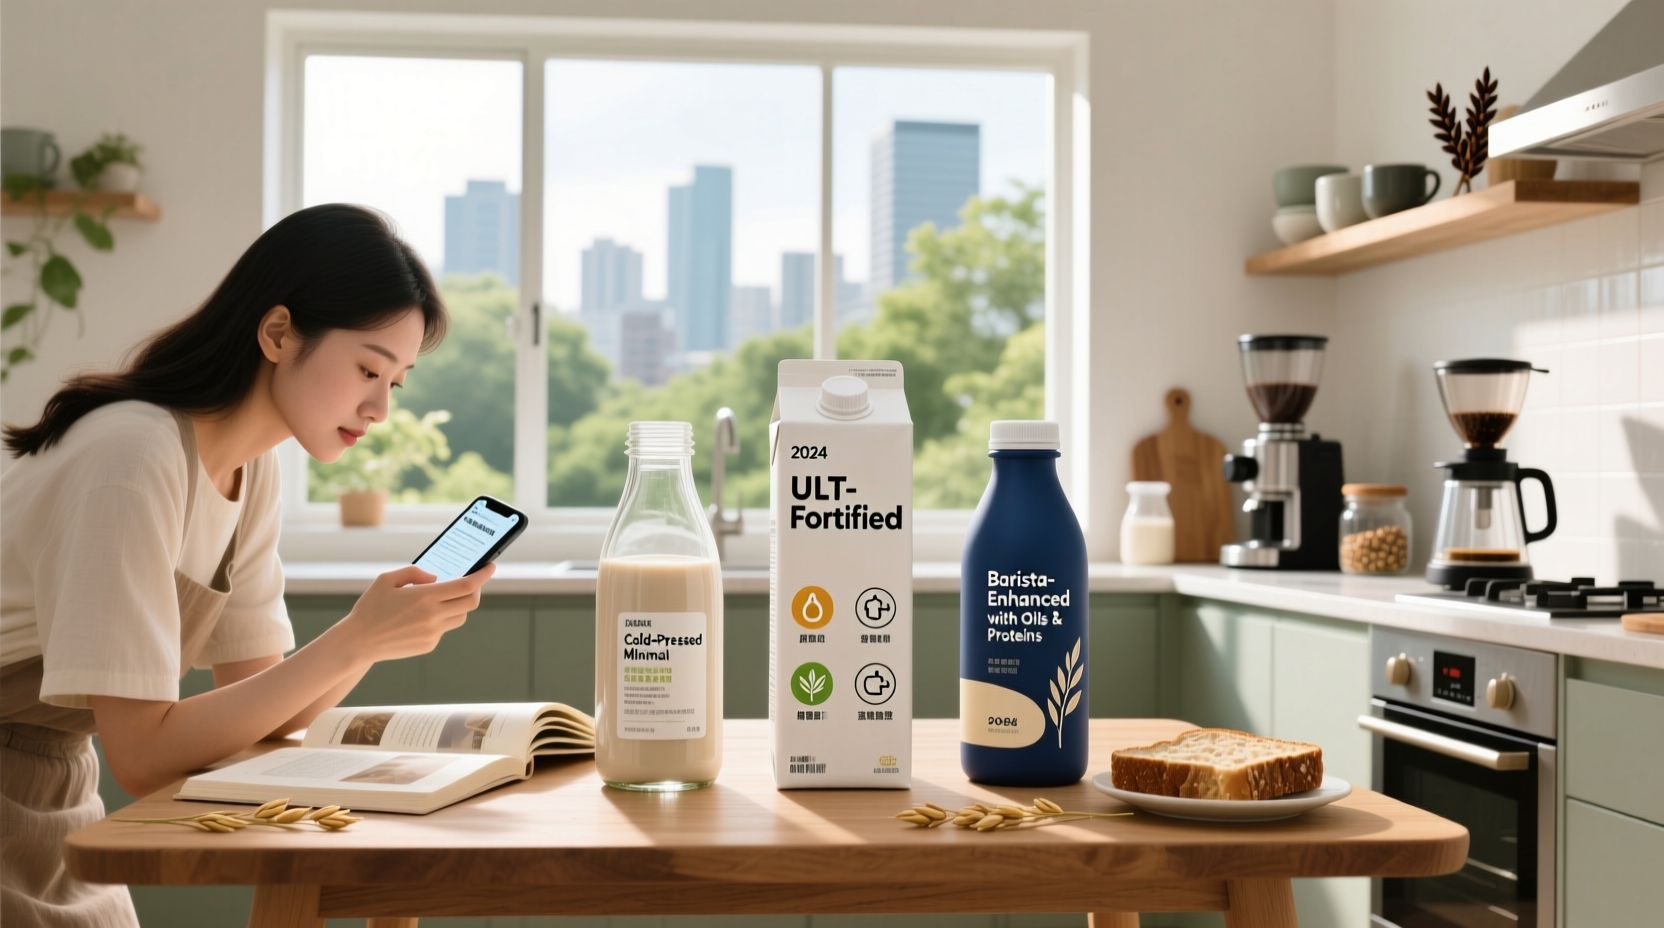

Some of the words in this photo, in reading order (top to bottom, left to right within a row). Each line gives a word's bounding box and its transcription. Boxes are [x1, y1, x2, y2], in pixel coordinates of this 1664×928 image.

[790, 445, 828, 460] 2024
[791, 475, 857, 501] ULT-
[790, 504, 903, 530] Fortified
[987, 570, 1055, 588] Barista-
[987, 589, 1070, 607] Enhanced
[987, 610, 1018, 626] with
[1052, 610, 1063, 625] &
[624, 632, 703, 647] Cold-Pressed
[987, 627, 1043, 643] Proteins
